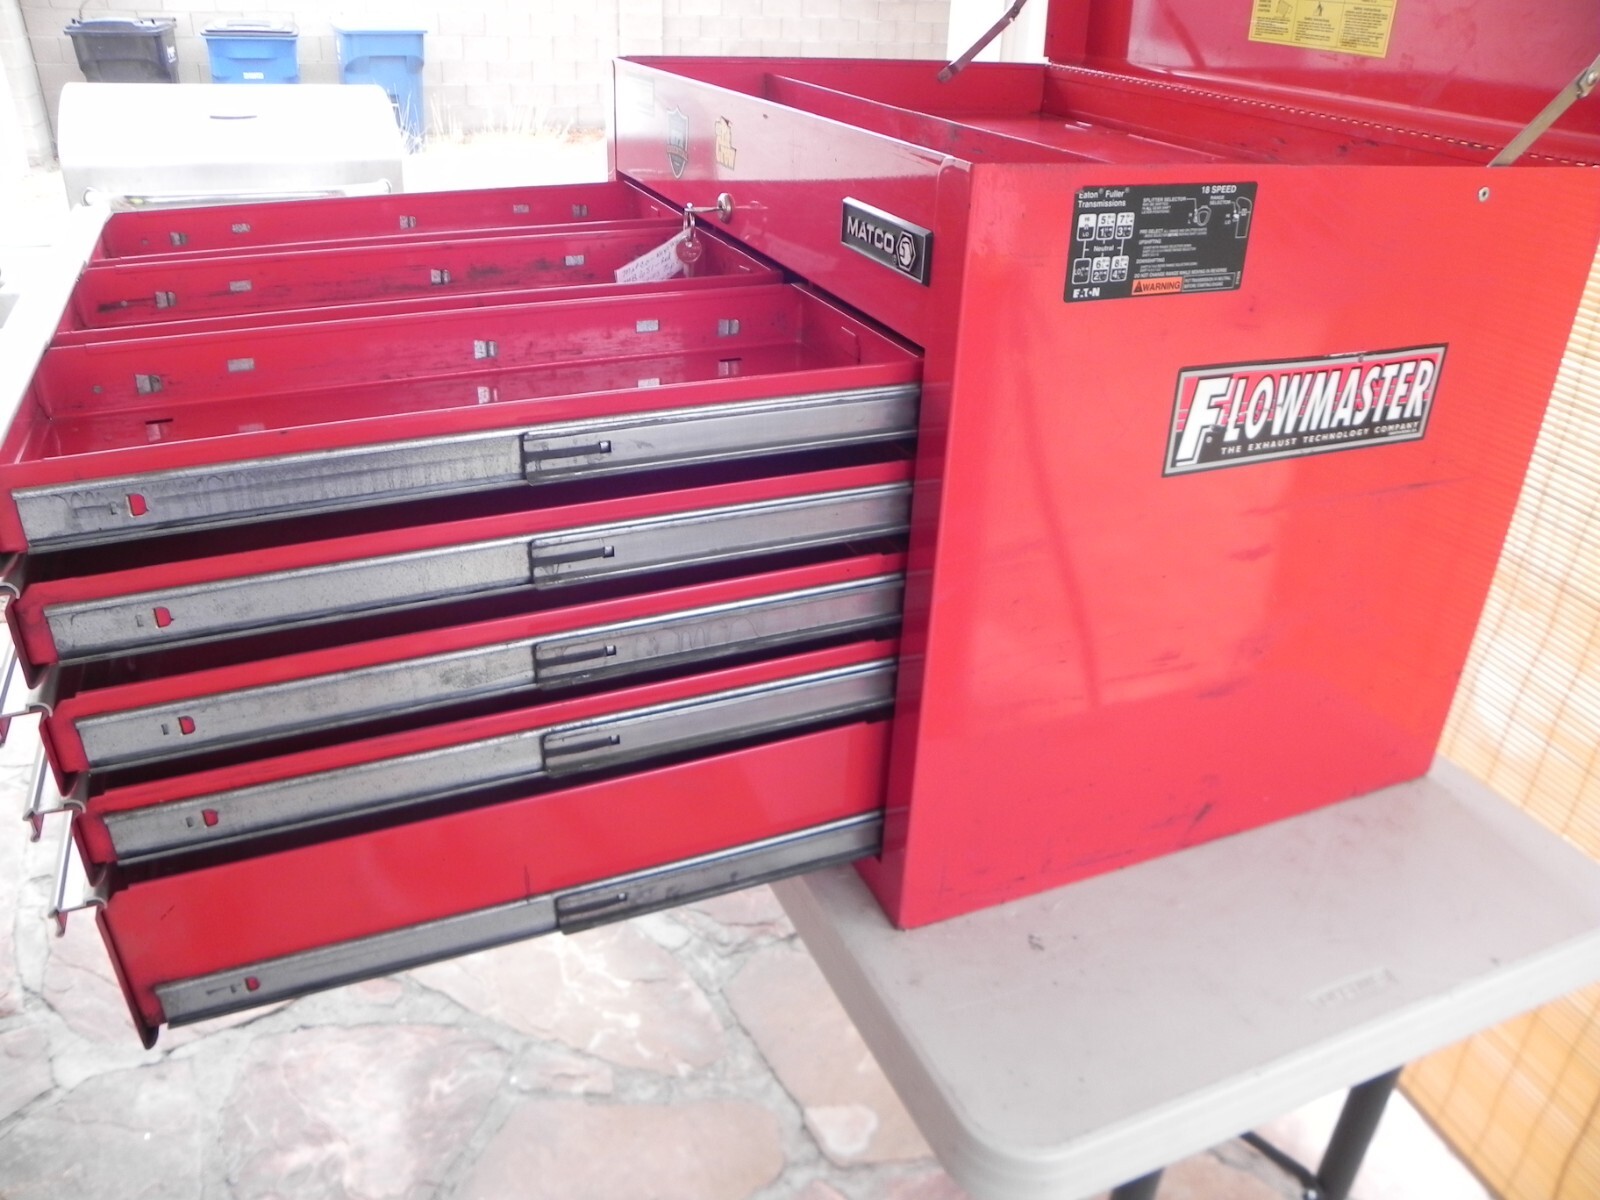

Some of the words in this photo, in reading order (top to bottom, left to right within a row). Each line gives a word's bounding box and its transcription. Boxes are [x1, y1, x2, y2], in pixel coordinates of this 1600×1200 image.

[1202, 186, 1210, 194] 18
[1211, 185, 1237, 194] SPEED
[1078, 200, 1127, 209] Transmissions
[1101, 215, 1107, 225] 5
[1119, 214, 1126, 224] 7
[847, 215, 895, 254] MATCO
[1117, 226, 1124, 237] 3
[1096, 259, 1102, 269] 6
[1114, 258, 1121, 268] 8
[1093, 271, 1100, 281] 2
[1112, 269, 1119, 279] 4
[1143, 281, 1181, 292] WARNING
[1174, 359, 1436, 466] FLOWMASTER
[1221, 446, 1243, 456] THE
[1247, 437, 1299, 452] EXHAUST
[1302, 428, 1371, 444] TECHNOLOGY
[1373, 420, 1421, 435] COMPANY
